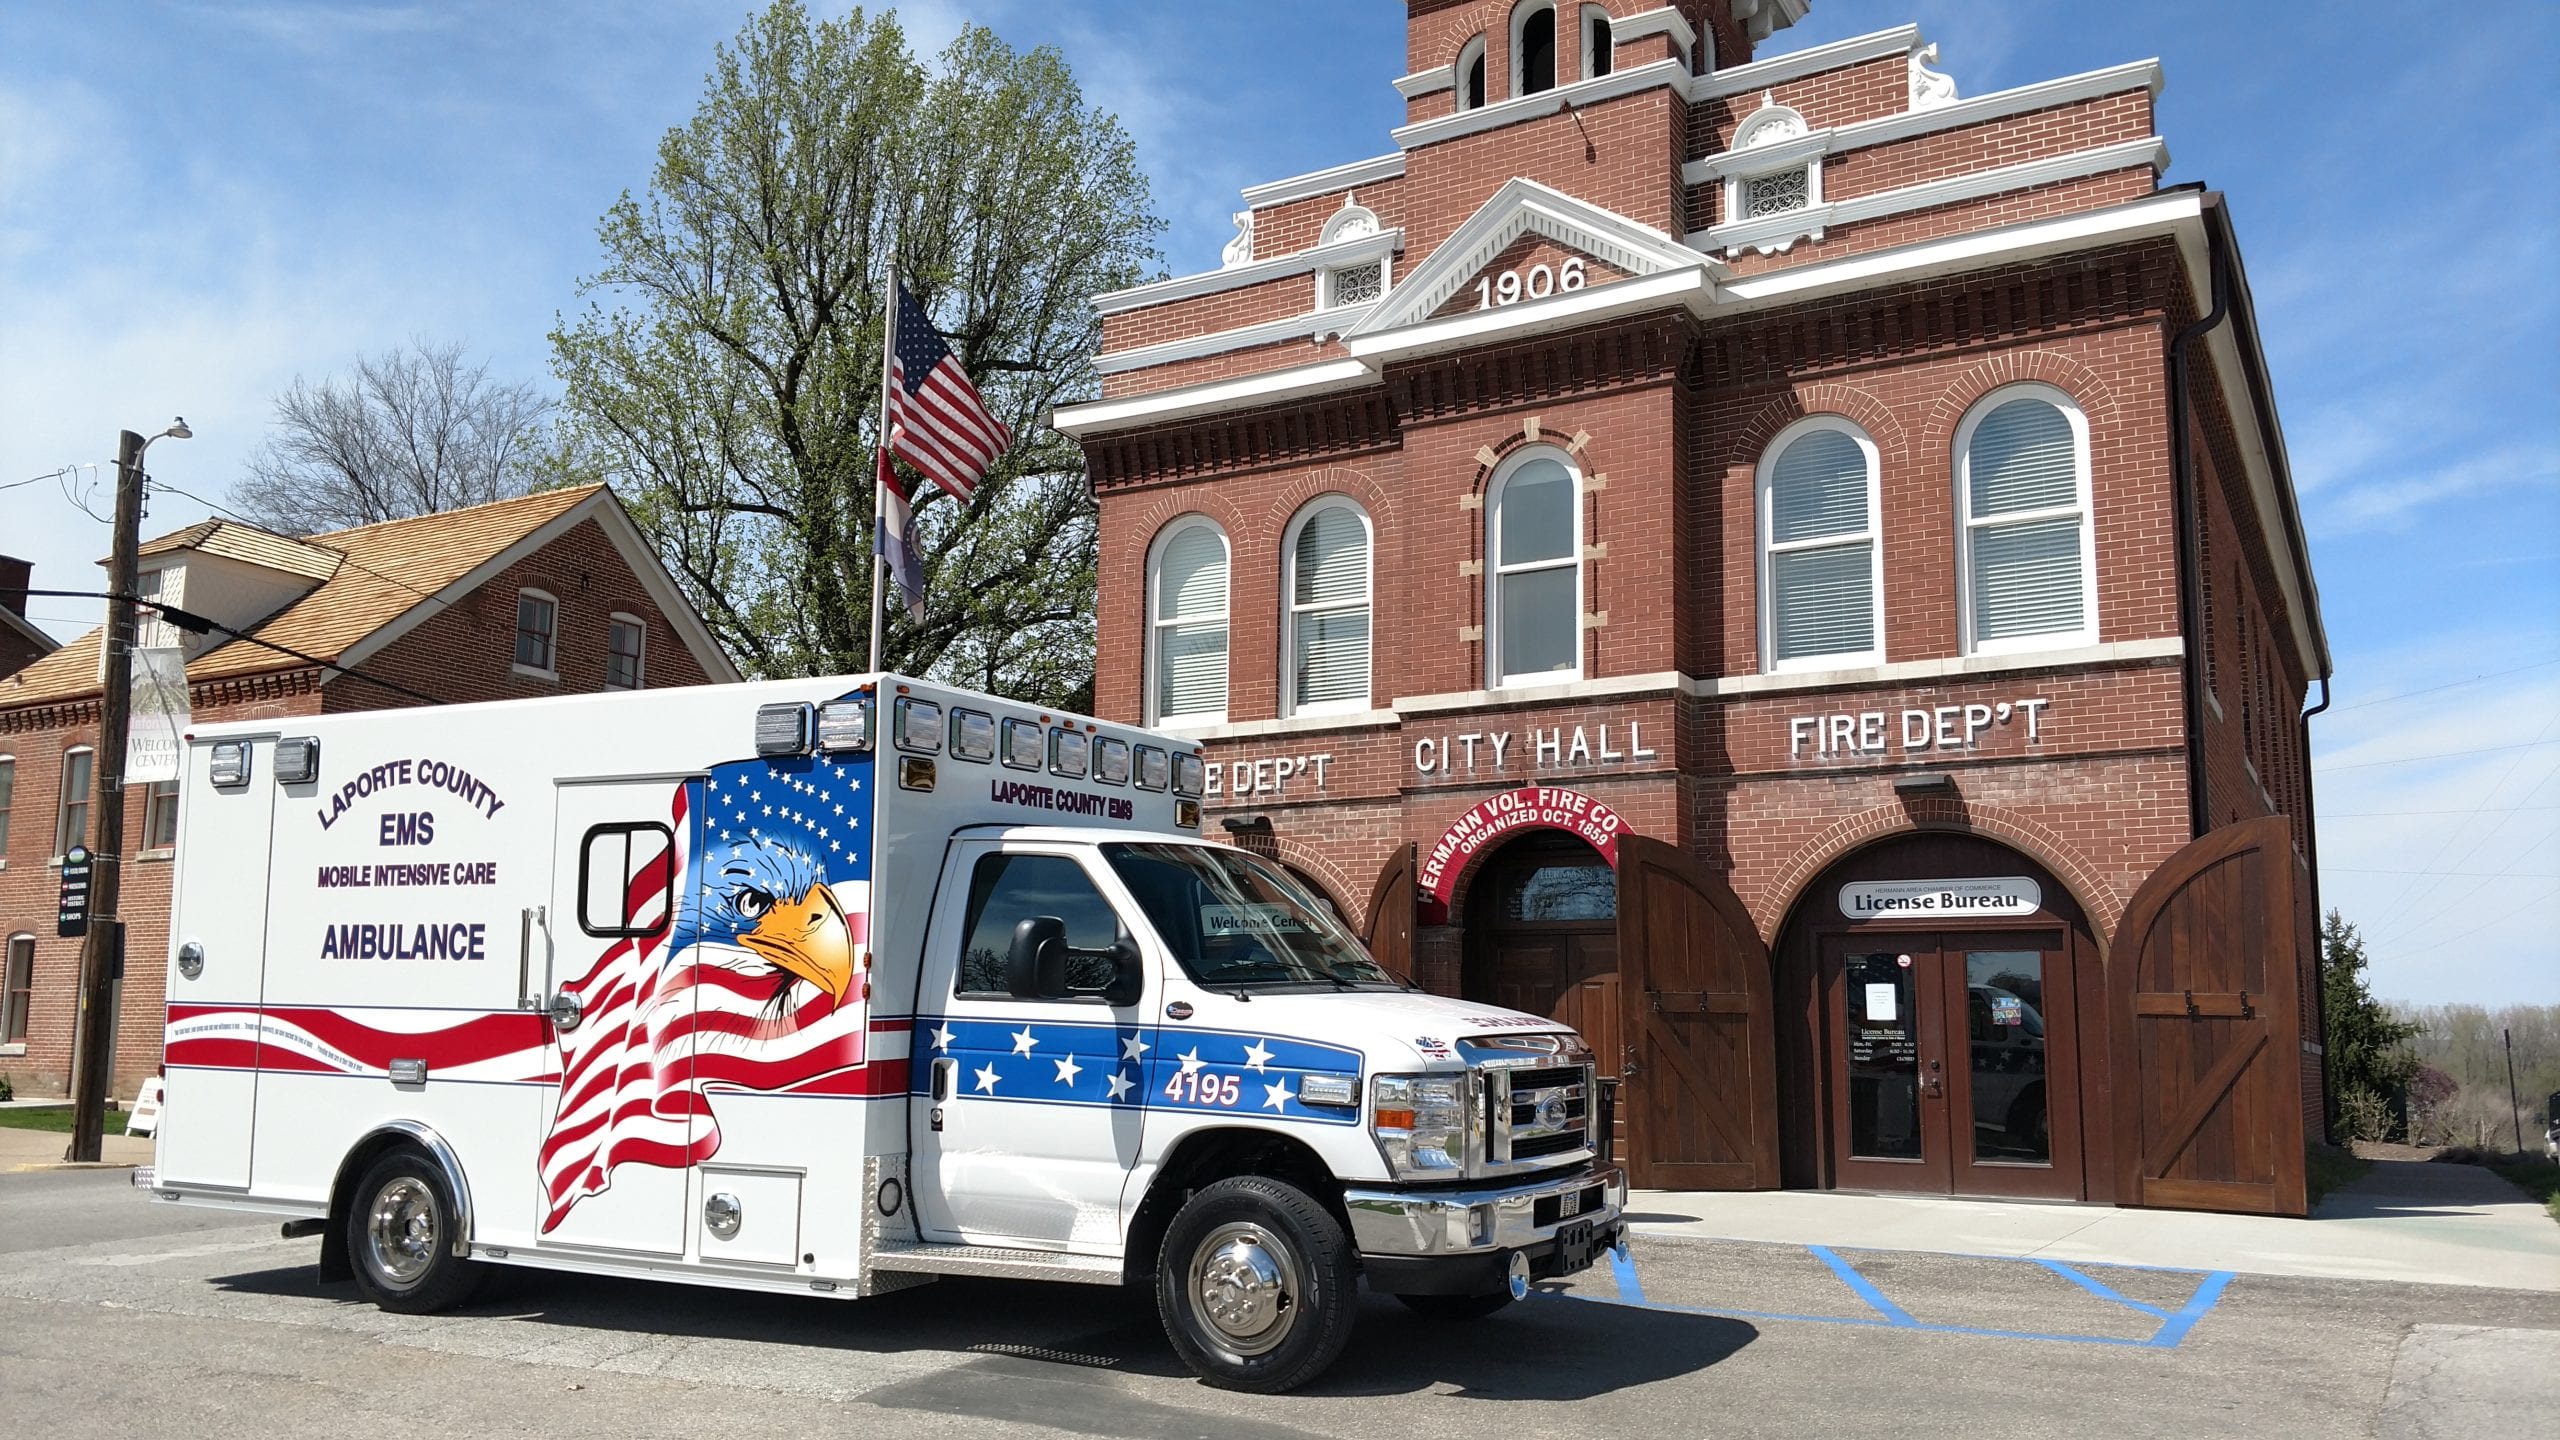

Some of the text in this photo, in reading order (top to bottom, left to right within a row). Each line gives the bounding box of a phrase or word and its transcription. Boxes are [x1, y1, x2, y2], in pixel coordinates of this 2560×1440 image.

[1474, 256, 1585, 310] 1906
[1415, 721, 1656, 772] CITY HALL
[1790, 698, 2048, 754] FIRE DEP'T
[1232, 754, 1332, 793] DEP'T
[317, 759, 505, 831] LAPORTE COUNTY
[991, 779, 1133, 821] LAPORTE COUNTY EMS
[379, 811, 434, 847] EMS
[1416, 808, 1483, 904] HERMANN
[1484, 791, 1533, 818] VOL.
[1538, 789, 1588, 816] FIRE
[1460, 808, 1609, 855] ORGANIZED OCT. 1859
[318, 862, 497, 888] MOBILE INTENSIVE CARE
[1855, 892, 2018, 911] License Bureau
[320, 922, 486, 961] AMBULANCE
[1164, 1070, 1241, 1108] 4195
